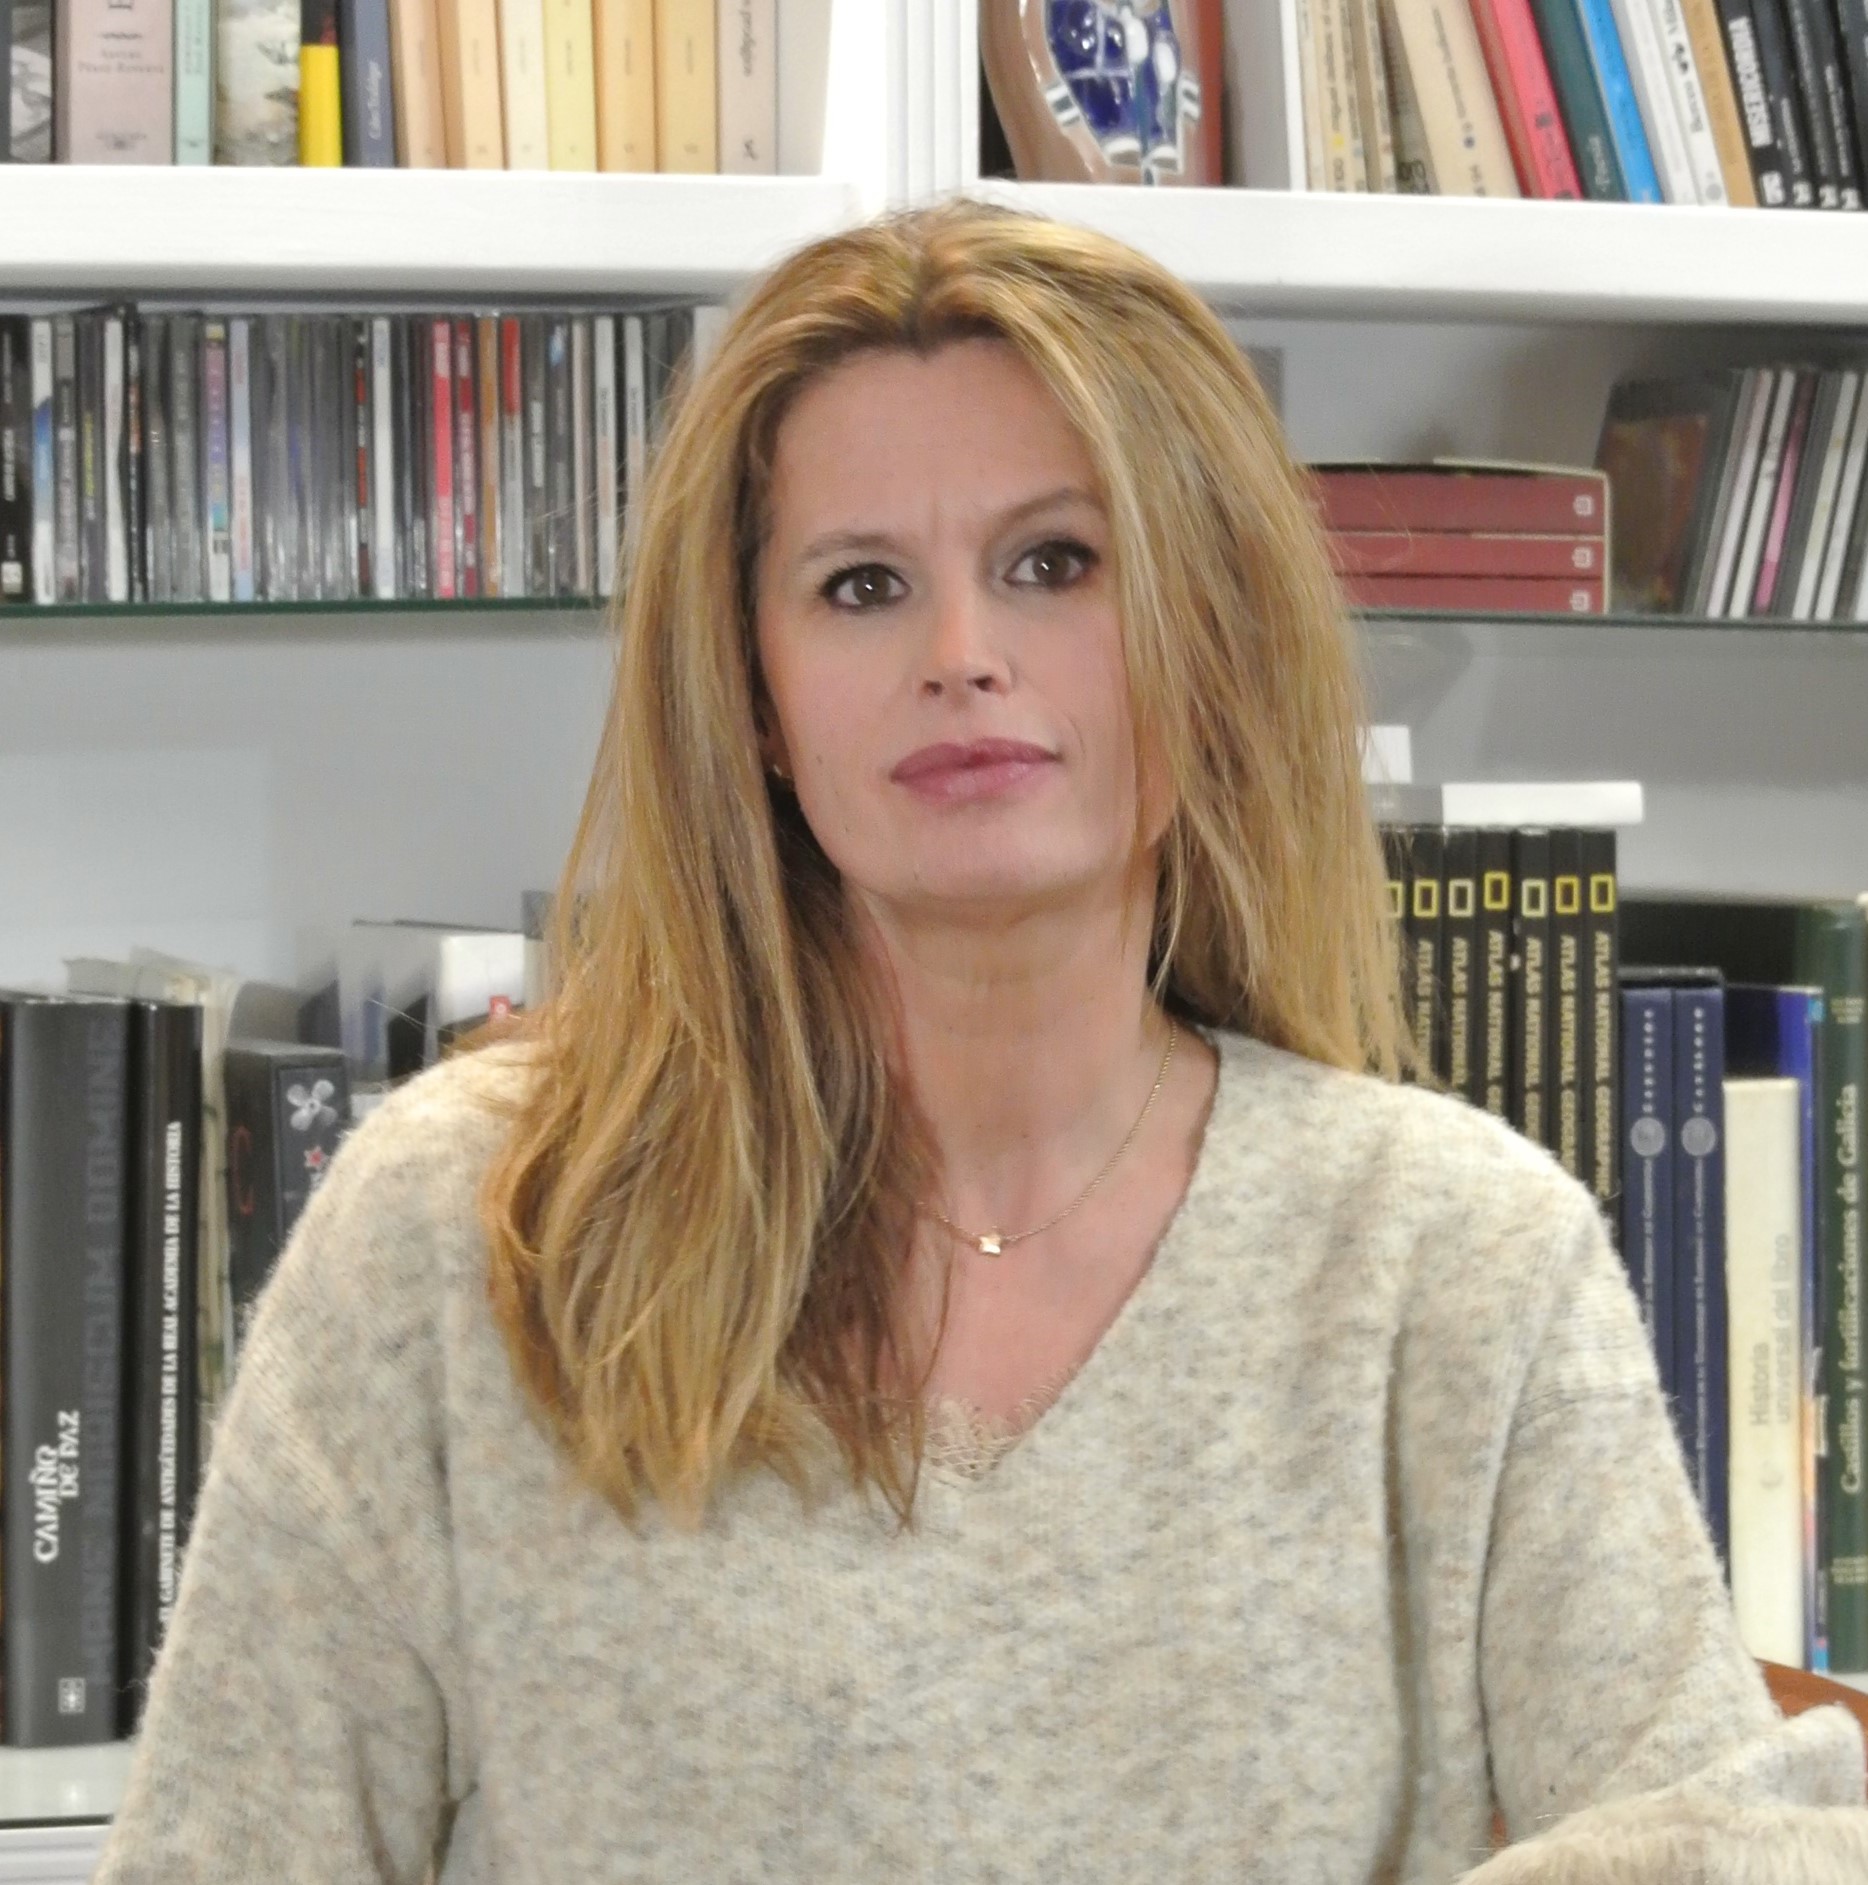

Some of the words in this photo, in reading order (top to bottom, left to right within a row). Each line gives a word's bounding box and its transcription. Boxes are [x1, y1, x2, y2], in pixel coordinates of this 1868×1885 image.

[1417, 939, 1434, 996] ATLAS
[1452, 937, 1468, 993] ATLAS
[1487, 930, 1504, 987] ATLAS
[1525, 936, 1542, 994] ATLAS
[1560, 934, 1577, 992] ATLAS
[1594, 931, 1611, 989] ATLAS
[1452, 997, 1468, 1085] NATIONAL
[1487, 990, 1504, 1080] NATIONAL
[1525, 998, 1541, 1088] NATIONAL
[1560, 994, 1576, 1084] NATIONAL
[1594, 992, 1611, 1082] NATIONAL
[1594, 1085, 1611, 1198] GEOGRAPHIC
[1836, 1083, 1858, 1166] Galicia
[165, 1121, 182, 1189] HISTORIA
[164, 1192, 182, 1210] LA
[1837, 1172, 1858, 1203] de
[164, 1213, 181, 1234] DE
[162, 1236, 181, 1311] ACADEMIA
[1770, 1233, 1790, 1281] libro
[1770, 1289, 1790, 1319] del
[1838, 1209, 1860, 1370] fortificaciones
[162, 1315, 180, 1350] REAL
[160, 1373, 178, 1396] DE
[161, 1353, 179, 1371] LA
[1748, 1342, 1769, 1425] Historia
[1772, 1328, 1791, 1424] universal
[1845, 1377, 1864, 1390] y
[57, 1409, 80, 1461] PAZ
[1839, 1398, 1861, 1494] Castillos
[29, 1444, 60, 1564] CAMIÑO
[58, 1463, 80, 1498] DE
[159, 1508, 177, 1534] DE
[158, 1536, 177, 1603] GABINETE
